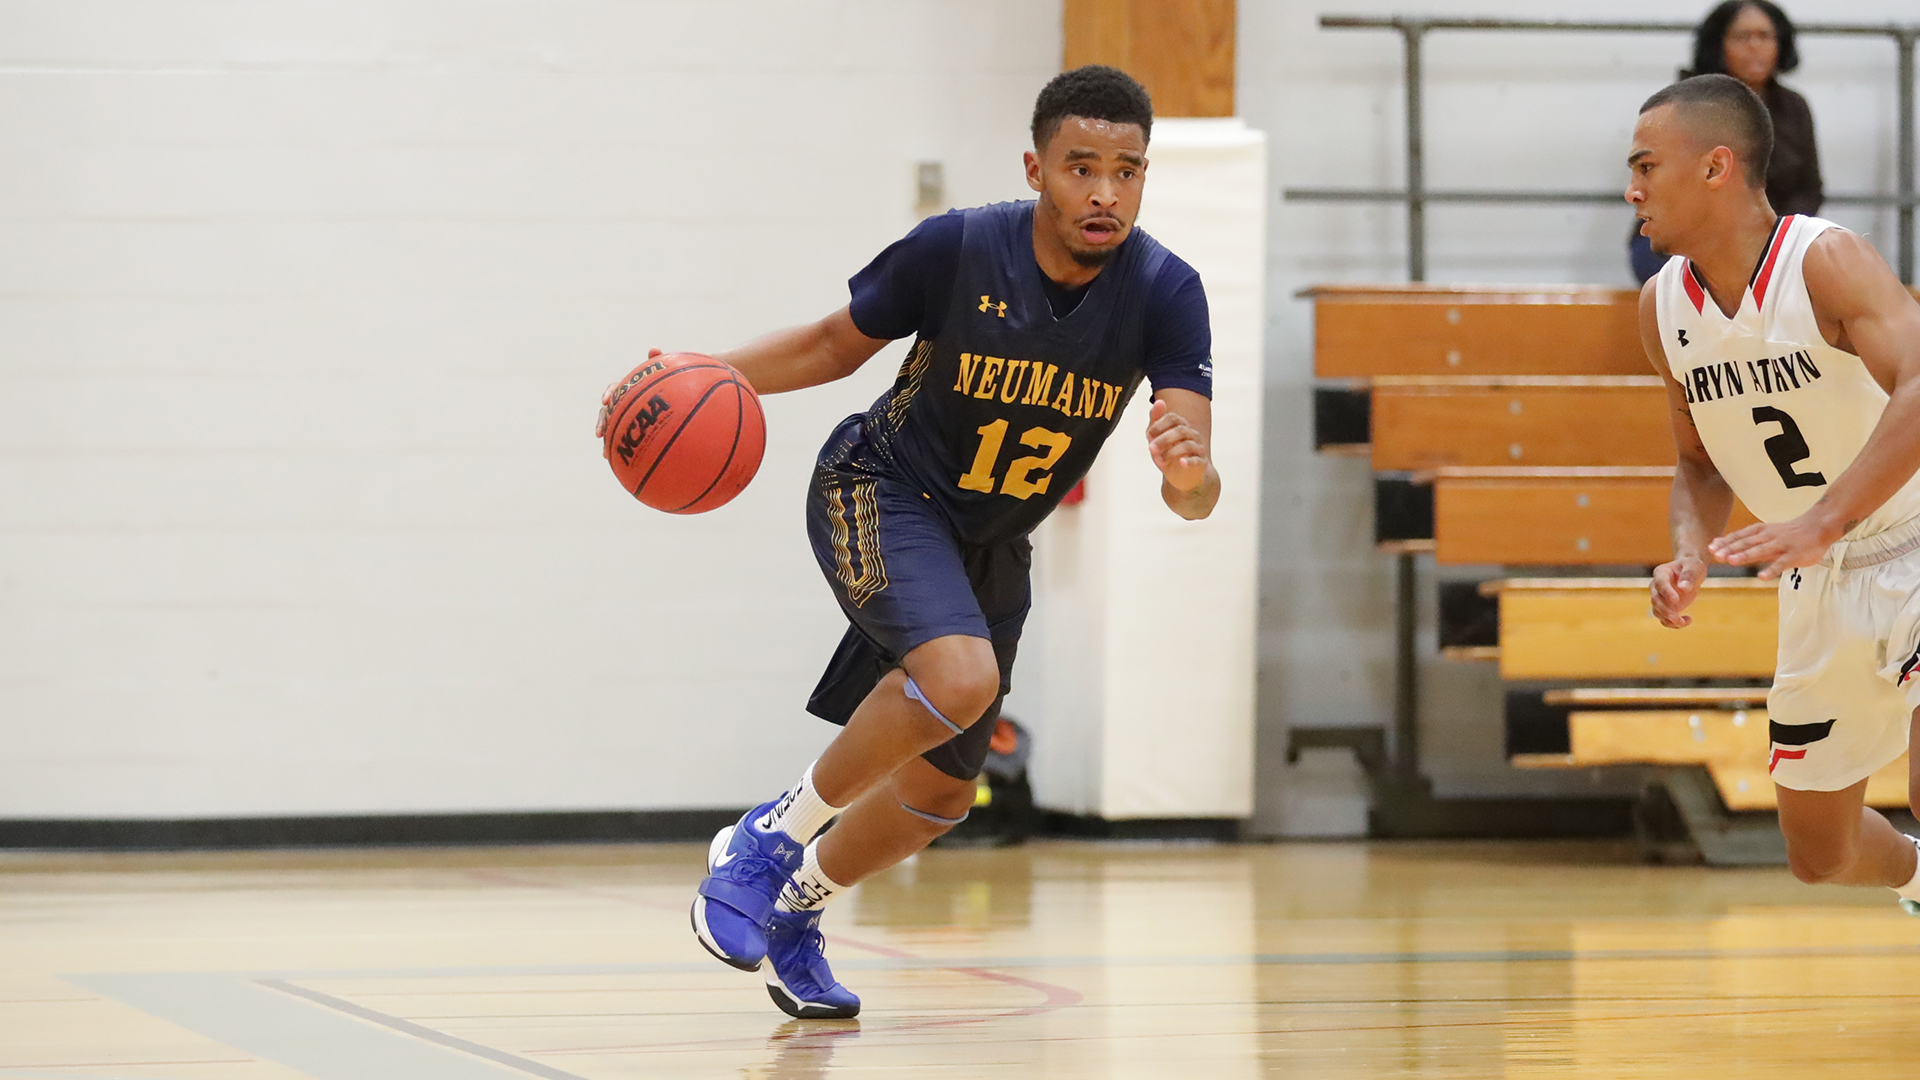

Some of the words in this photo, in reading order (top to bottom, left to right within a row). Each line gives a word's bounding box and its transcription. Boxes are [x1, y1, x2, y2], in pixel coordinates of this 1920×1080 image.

[953, 352, 1123, 421] NEUMANN
[616, 395, 671, 467] NCAA
[957, 418, 1073, 500] 12
[1752, 406, 1827, 489] 2
